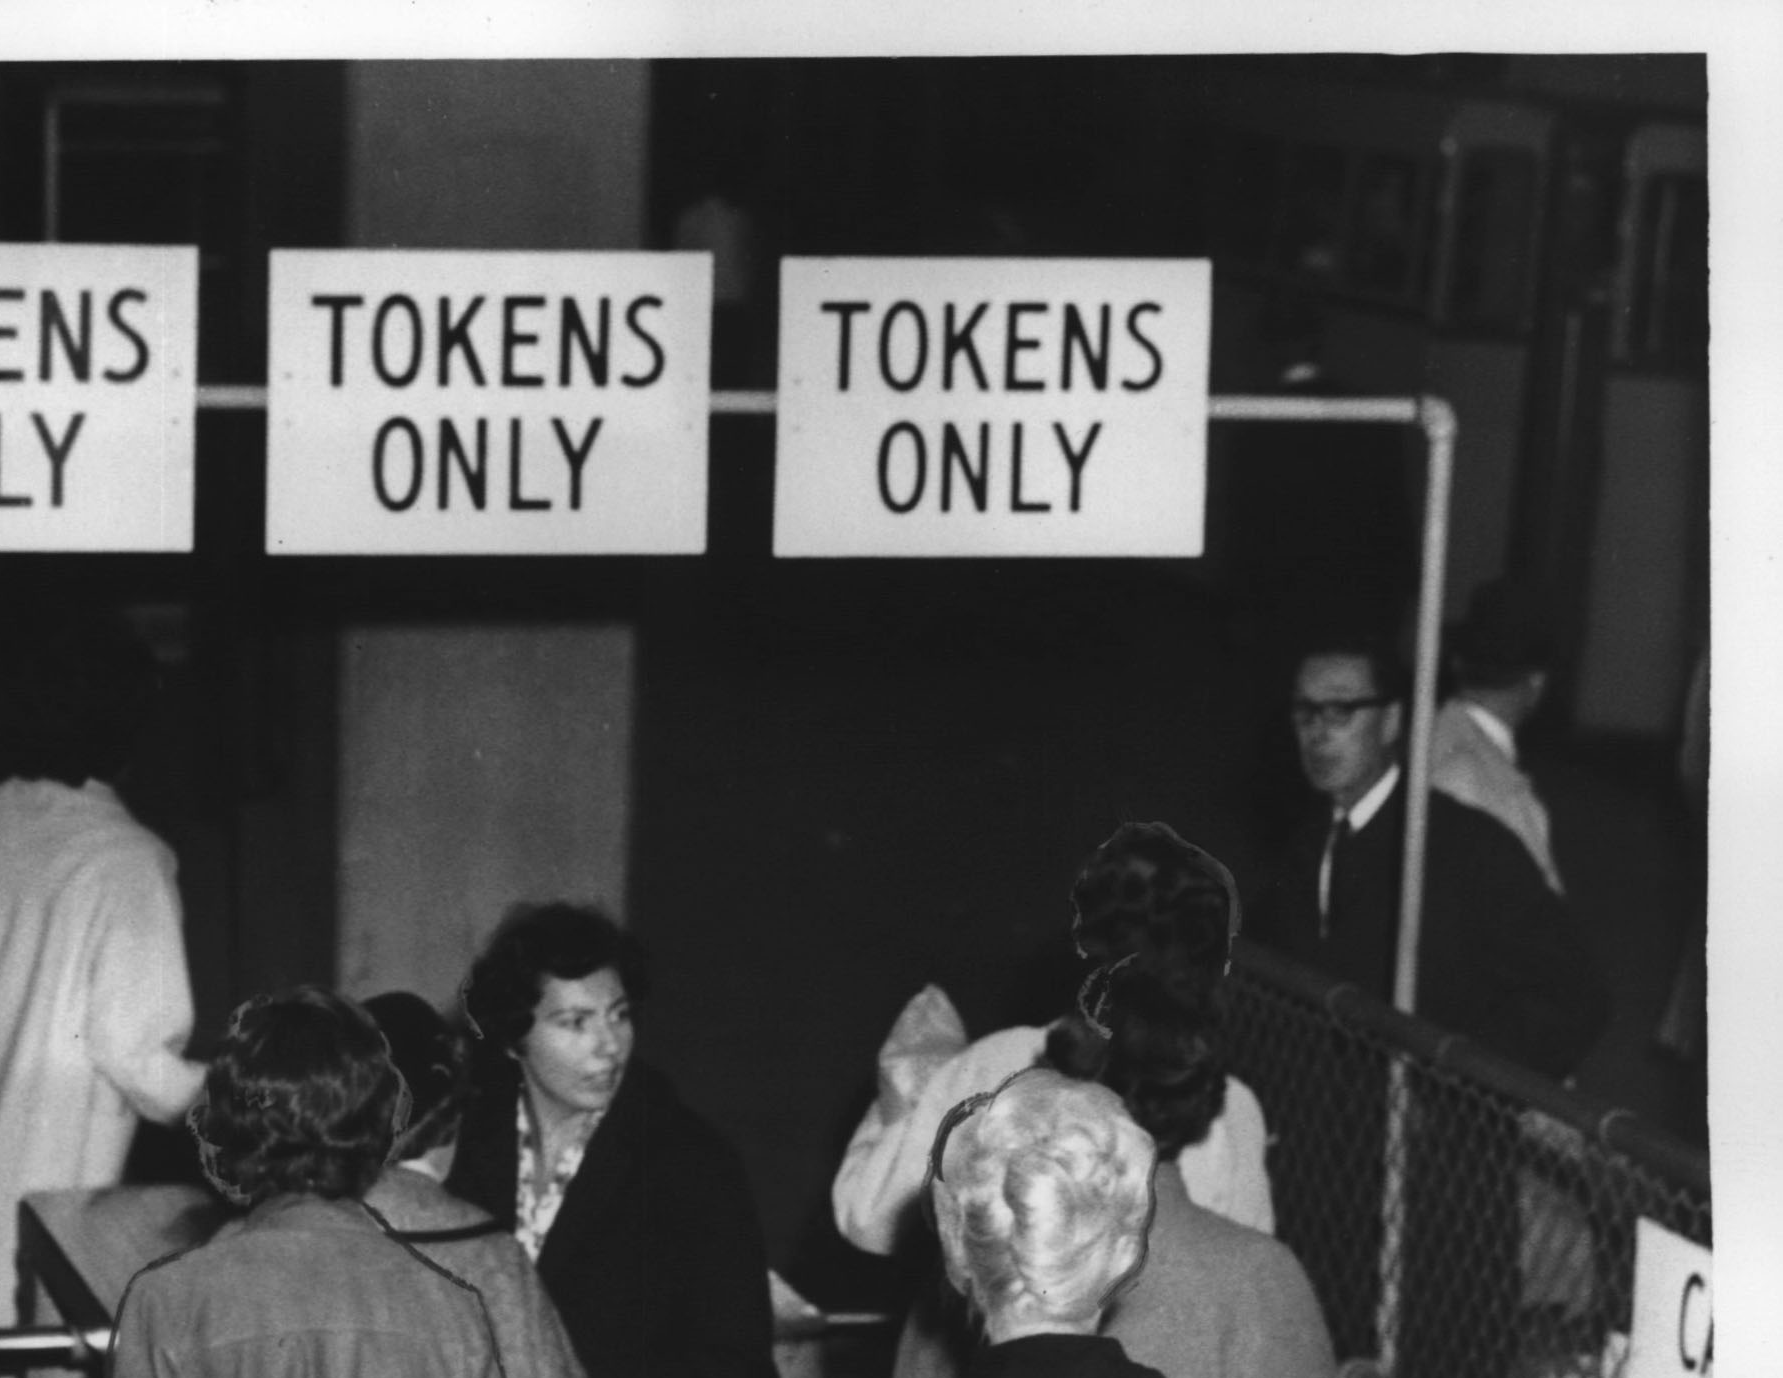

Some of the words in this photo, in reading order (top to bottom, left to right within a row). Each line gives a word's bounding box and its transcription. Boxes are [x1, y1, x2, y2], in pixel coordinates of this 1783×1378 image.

[311, 293, 666, 390] TOKENS
[819, 299, 1163, 394] TOKENS
[372, 415, 603, 513] ONLY
[876, 420, 1102, 515] ONLY
